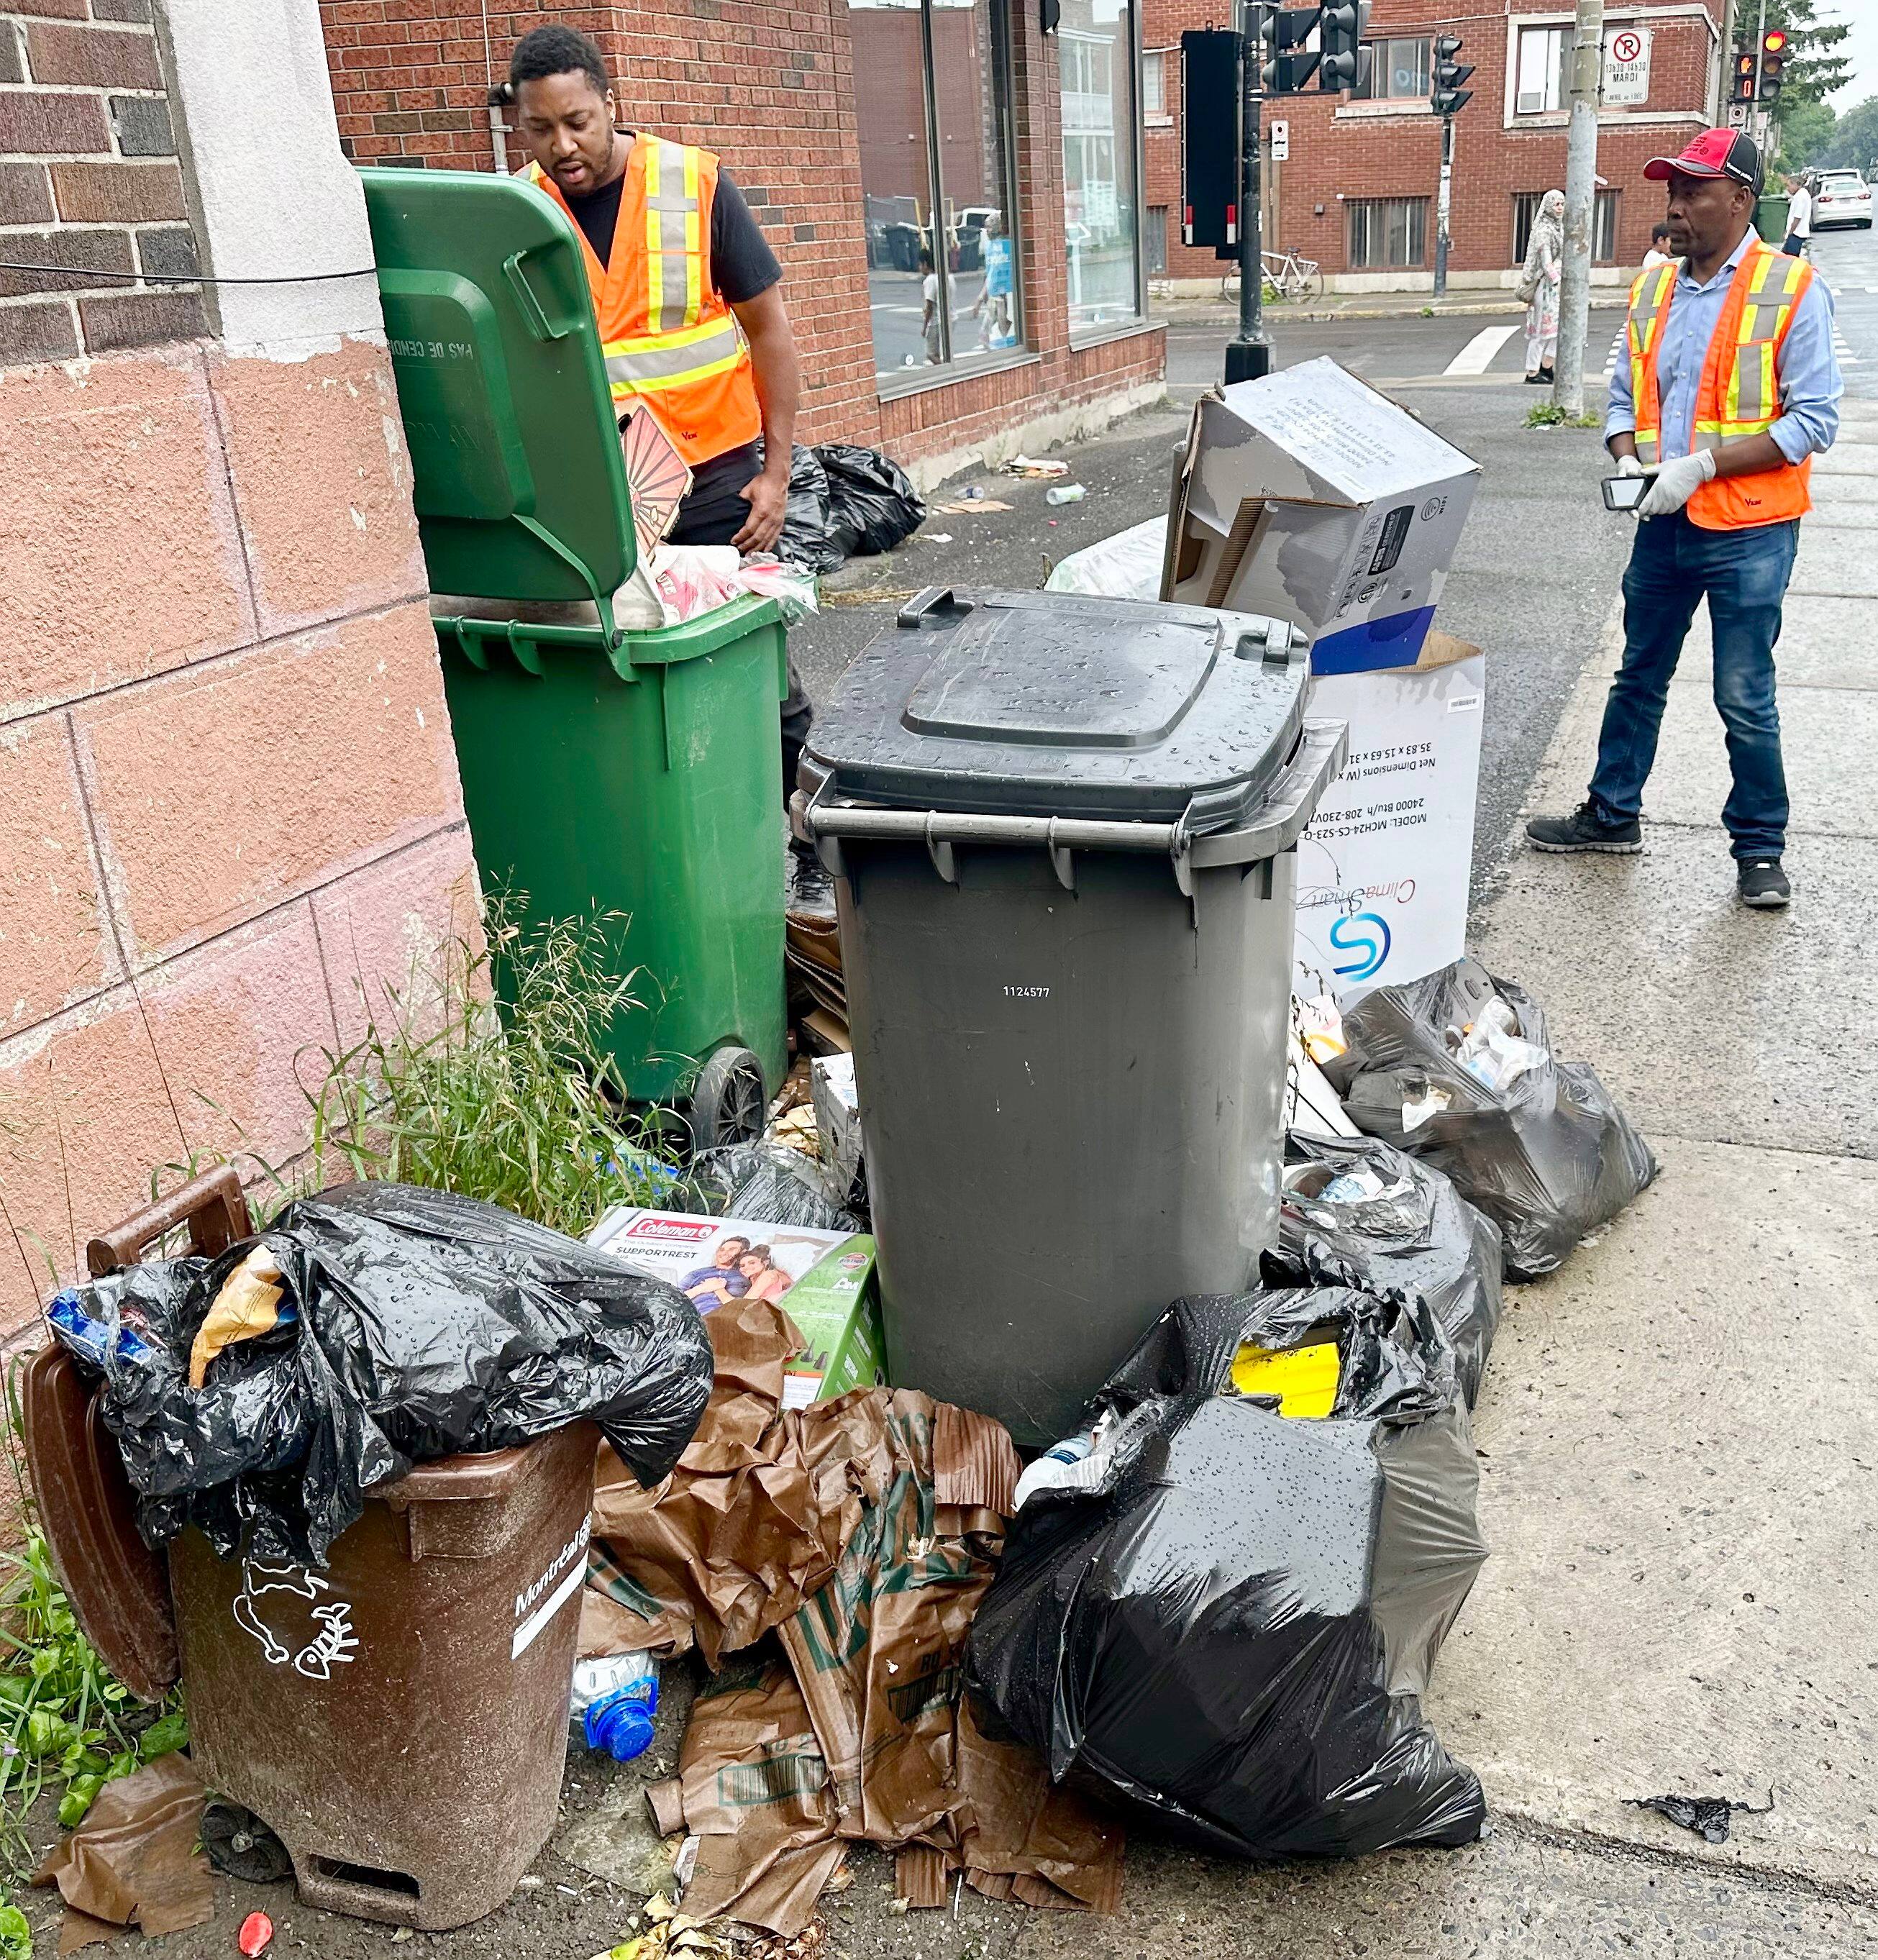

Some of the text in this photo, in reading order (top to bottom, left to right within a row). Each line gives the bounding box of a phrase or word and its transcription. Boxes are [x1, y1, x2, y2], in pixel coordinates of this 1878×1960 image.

[1613, 73, 1638, 82] MARDI
[428, 342, 445, 358] DE
[449, 343, 473, 360] PAS
[1370, 747, 1396, 762] 15.63
[1405, 742, 1432, 756] 35.83
[1363, 760, 1417, 778] Dimensions
[1419, 757, 1436, 770] Net
[1346, 767, 1362, 781] (W
[1367, 801, 1393, 817] Btu/h
[1395, 798, 1424, 811] 24000
[1390, 813, 1427, 827] MODEL:
[1003, 986, 1049, 997] 1124577
[636, 1219, 699, 1238] Coleman
[616, 1246, 698, 1259] SUPPORTREST
[515, 1530, 579, 1618] Montréal
